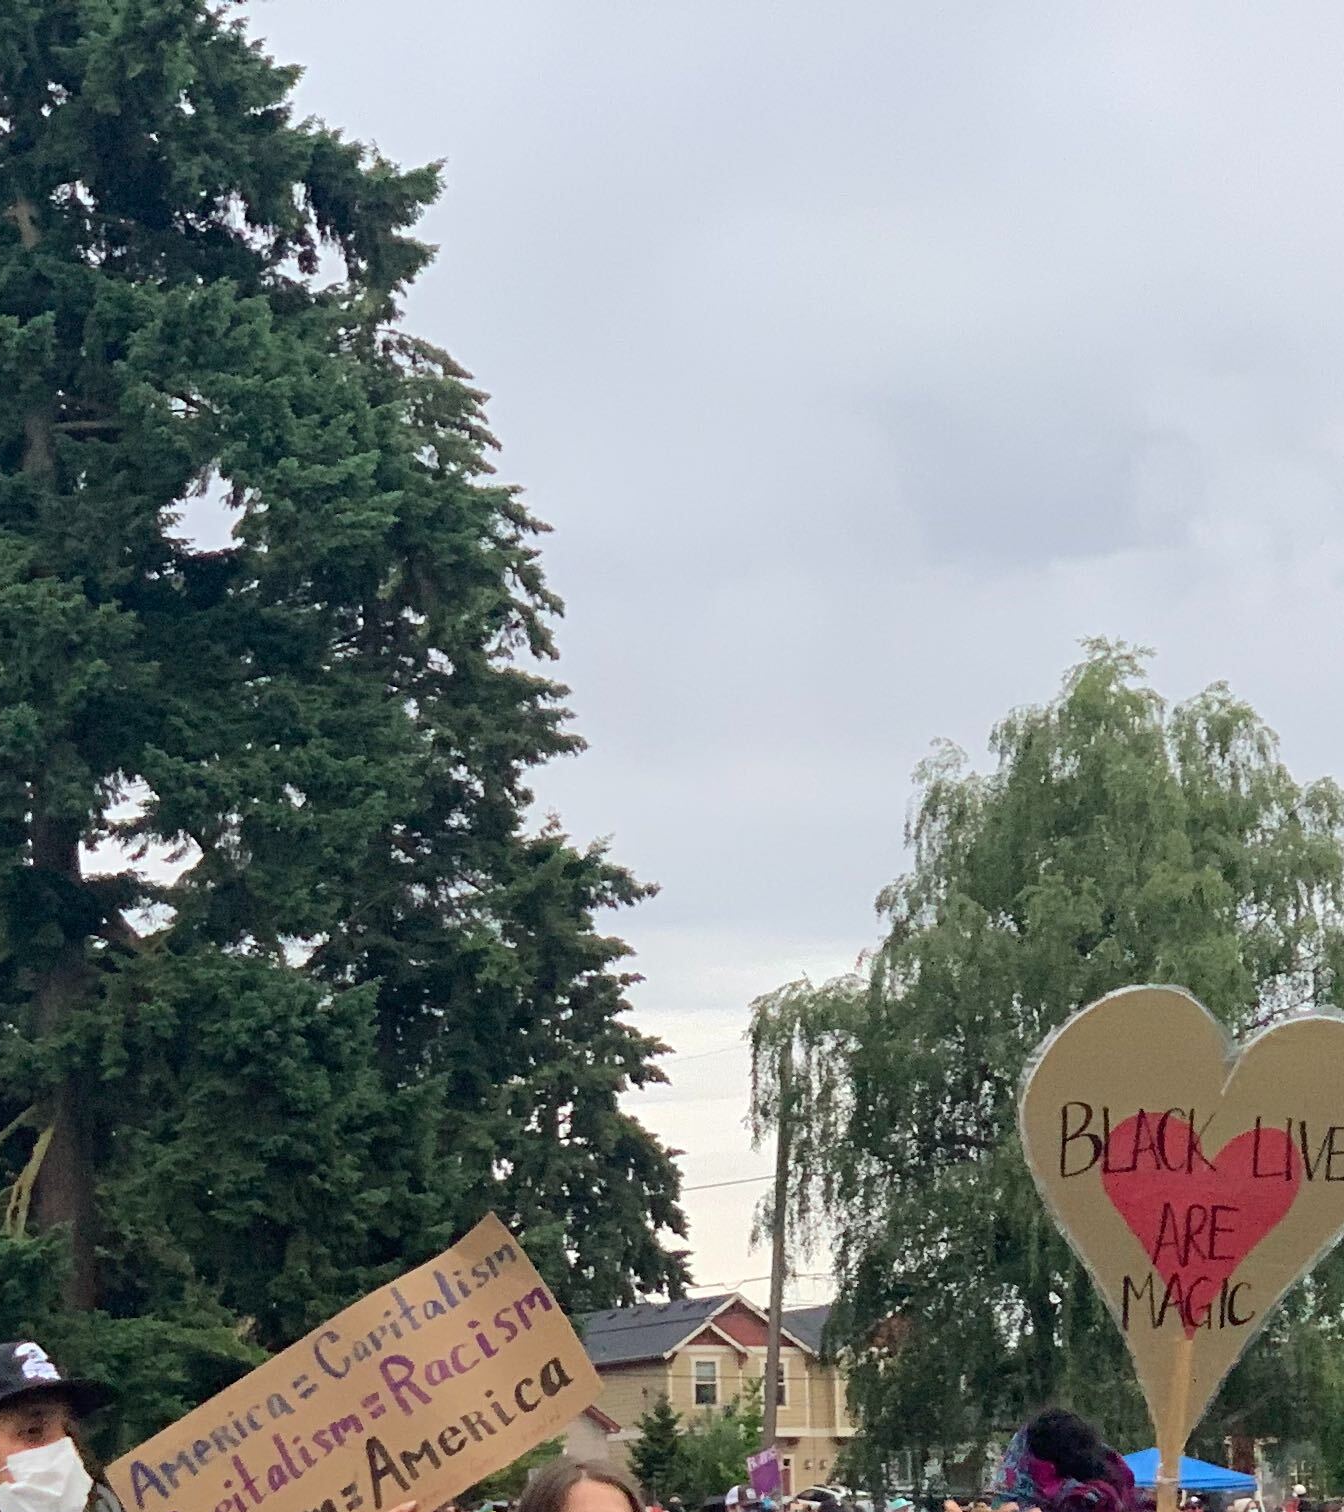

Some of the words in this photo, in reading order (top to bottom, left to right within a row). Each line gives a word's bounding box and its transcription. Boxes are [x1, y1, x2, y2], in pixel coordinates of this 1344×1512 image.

[1060, 1101, 1216, 1177] BLACK
[1152, 1202, 1239, 1267] ARE
[1122, 1272, 1255, 1330] MAGIC
